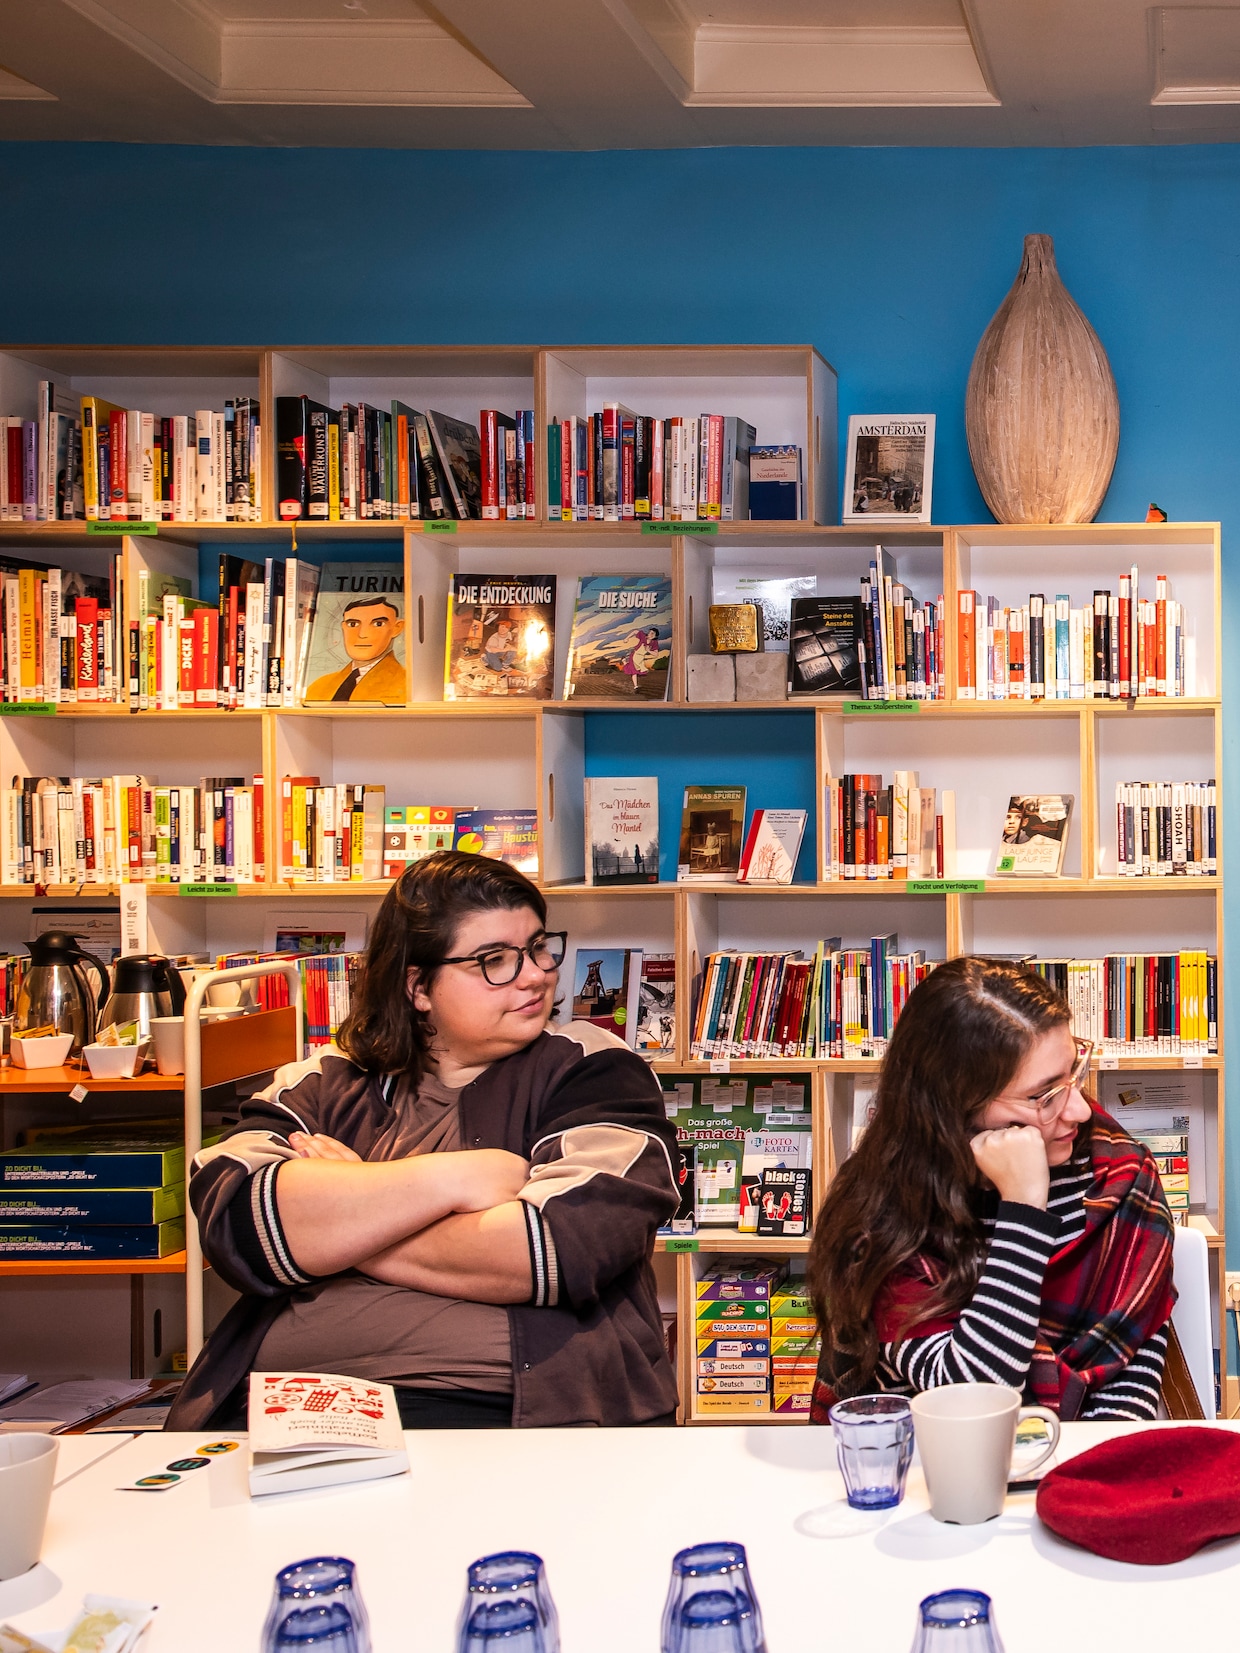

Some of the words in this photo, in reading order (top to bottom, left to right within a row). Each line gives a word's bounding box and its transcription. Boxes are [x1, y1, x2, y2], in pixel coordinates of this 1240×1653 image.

[857, 425, 926, 436] AMSTERDAM
[316, 427, 325, 494] MAUERKUNST
[336, 575, 404, 594] TURIN
[51, 590, 59, 607] FISCH
[458, 586, 477, 604] DIE
[480, 585, 552, 604] ENTDECKUNG
[598, 592, 619, 608] DIE
[619, 592, 657, 609] SUCHE
[50, 608, 58, 626] NASSE
[21, 612, 32, 660] Heimat
[50, 628, 58, 639] DER
[79, 623, 94, 681] Kinderland
[181, 637, 192, 669] DICKE
[4, 705, 27, 713] Graphic
[873, 703, 913, 711] Stolpersteine
[713, 792, 741, 800] SPUREN
[613, 798, 651, 811] Mädchen
[620, 812, 640, 820] blauen
[611, 823, 643, 834] Mantel
[1175, 806, 1183, 845] SHOAH
[503, 831, 537, 843] Haustü
[1026, 848, 1053, 856] JUNGE
[913, 882, 931, 890] Flucht
[932, 882, 944, 890] und
[945, 882, 978, 890] Verfolgung
[706, 1118, 732, 1127] große
[697, 1142, 720, 1151] Spiel
[765, 1137, 792, 1146] FOTO
[764, 1145, 799, 1153] KARTEN
[765, 1170, 796, 1182] black
[793, 1172, 807, 1213] stories
[674, 1242, 692, 1250] Spiele
[720, 1380, 744, 1388] Deutsch
[313, 1430, 378, 1440] Koffiebars
